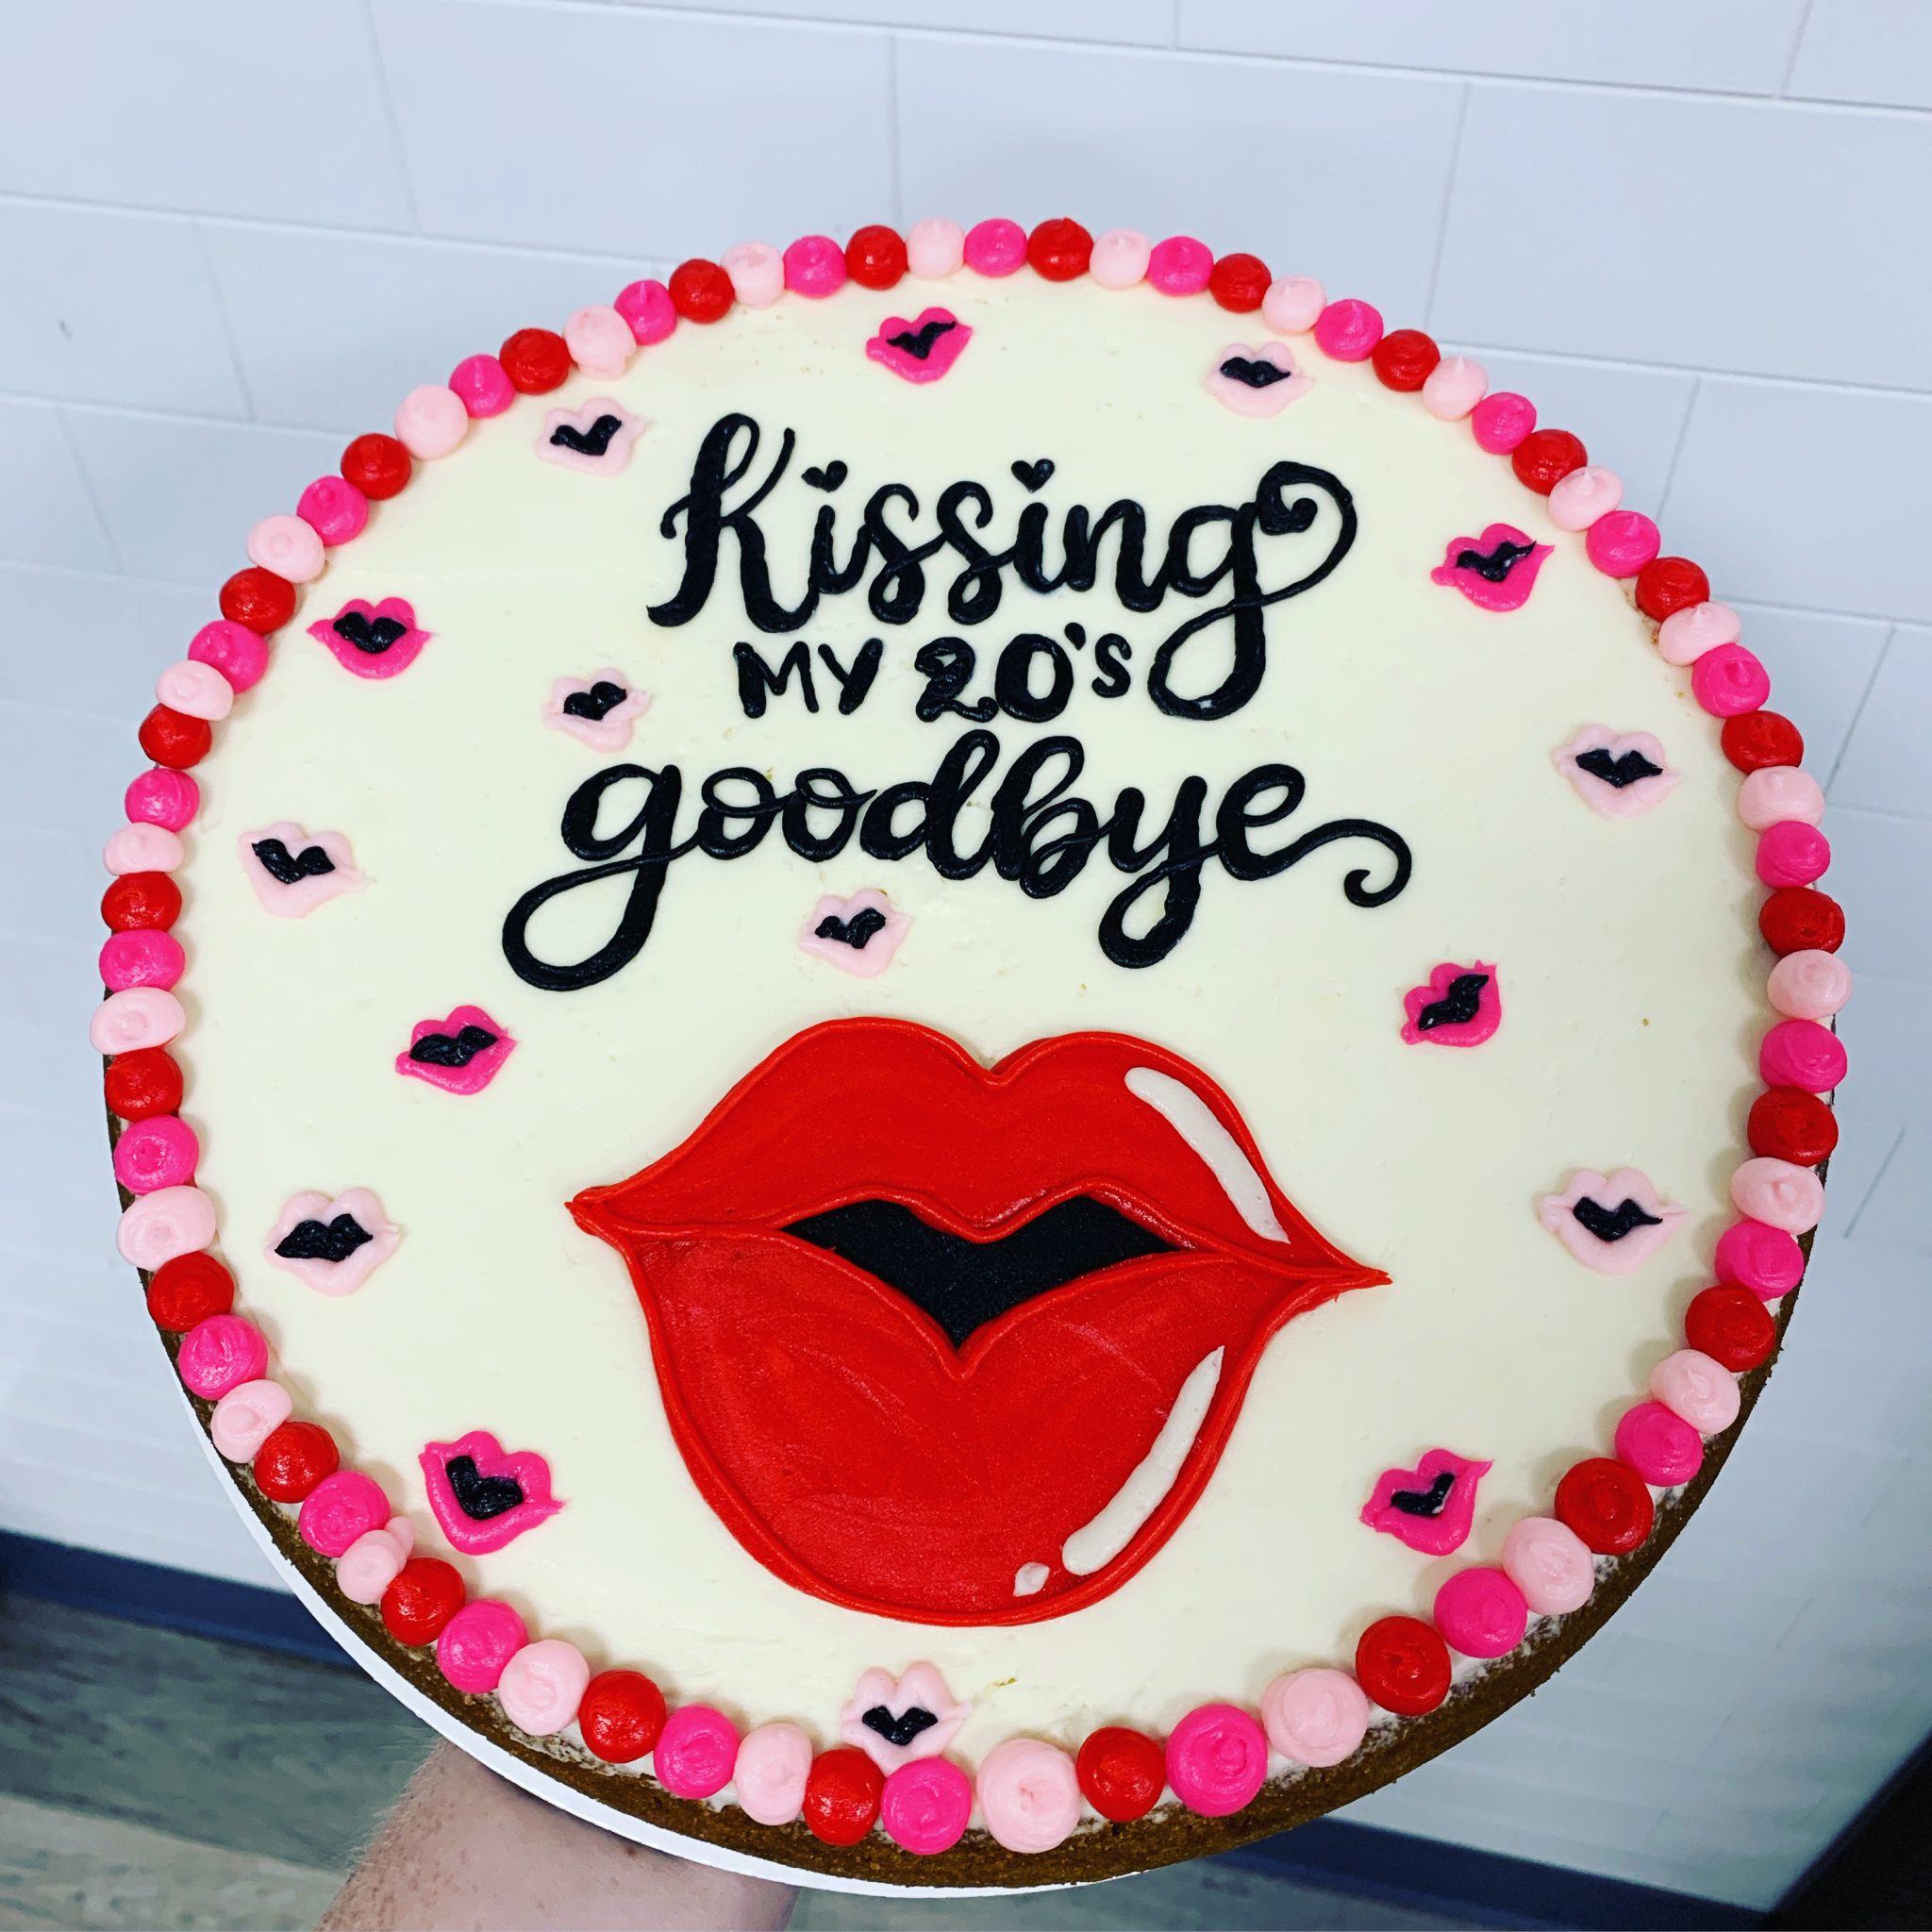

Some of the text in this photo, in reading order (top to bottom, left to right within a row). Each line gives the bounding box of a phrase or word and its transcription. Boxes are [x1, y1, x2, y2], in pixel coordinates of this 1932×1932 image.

[732, 622, 1133, 724] MY 20's
[501, 728, 1413, 992] goodbye
